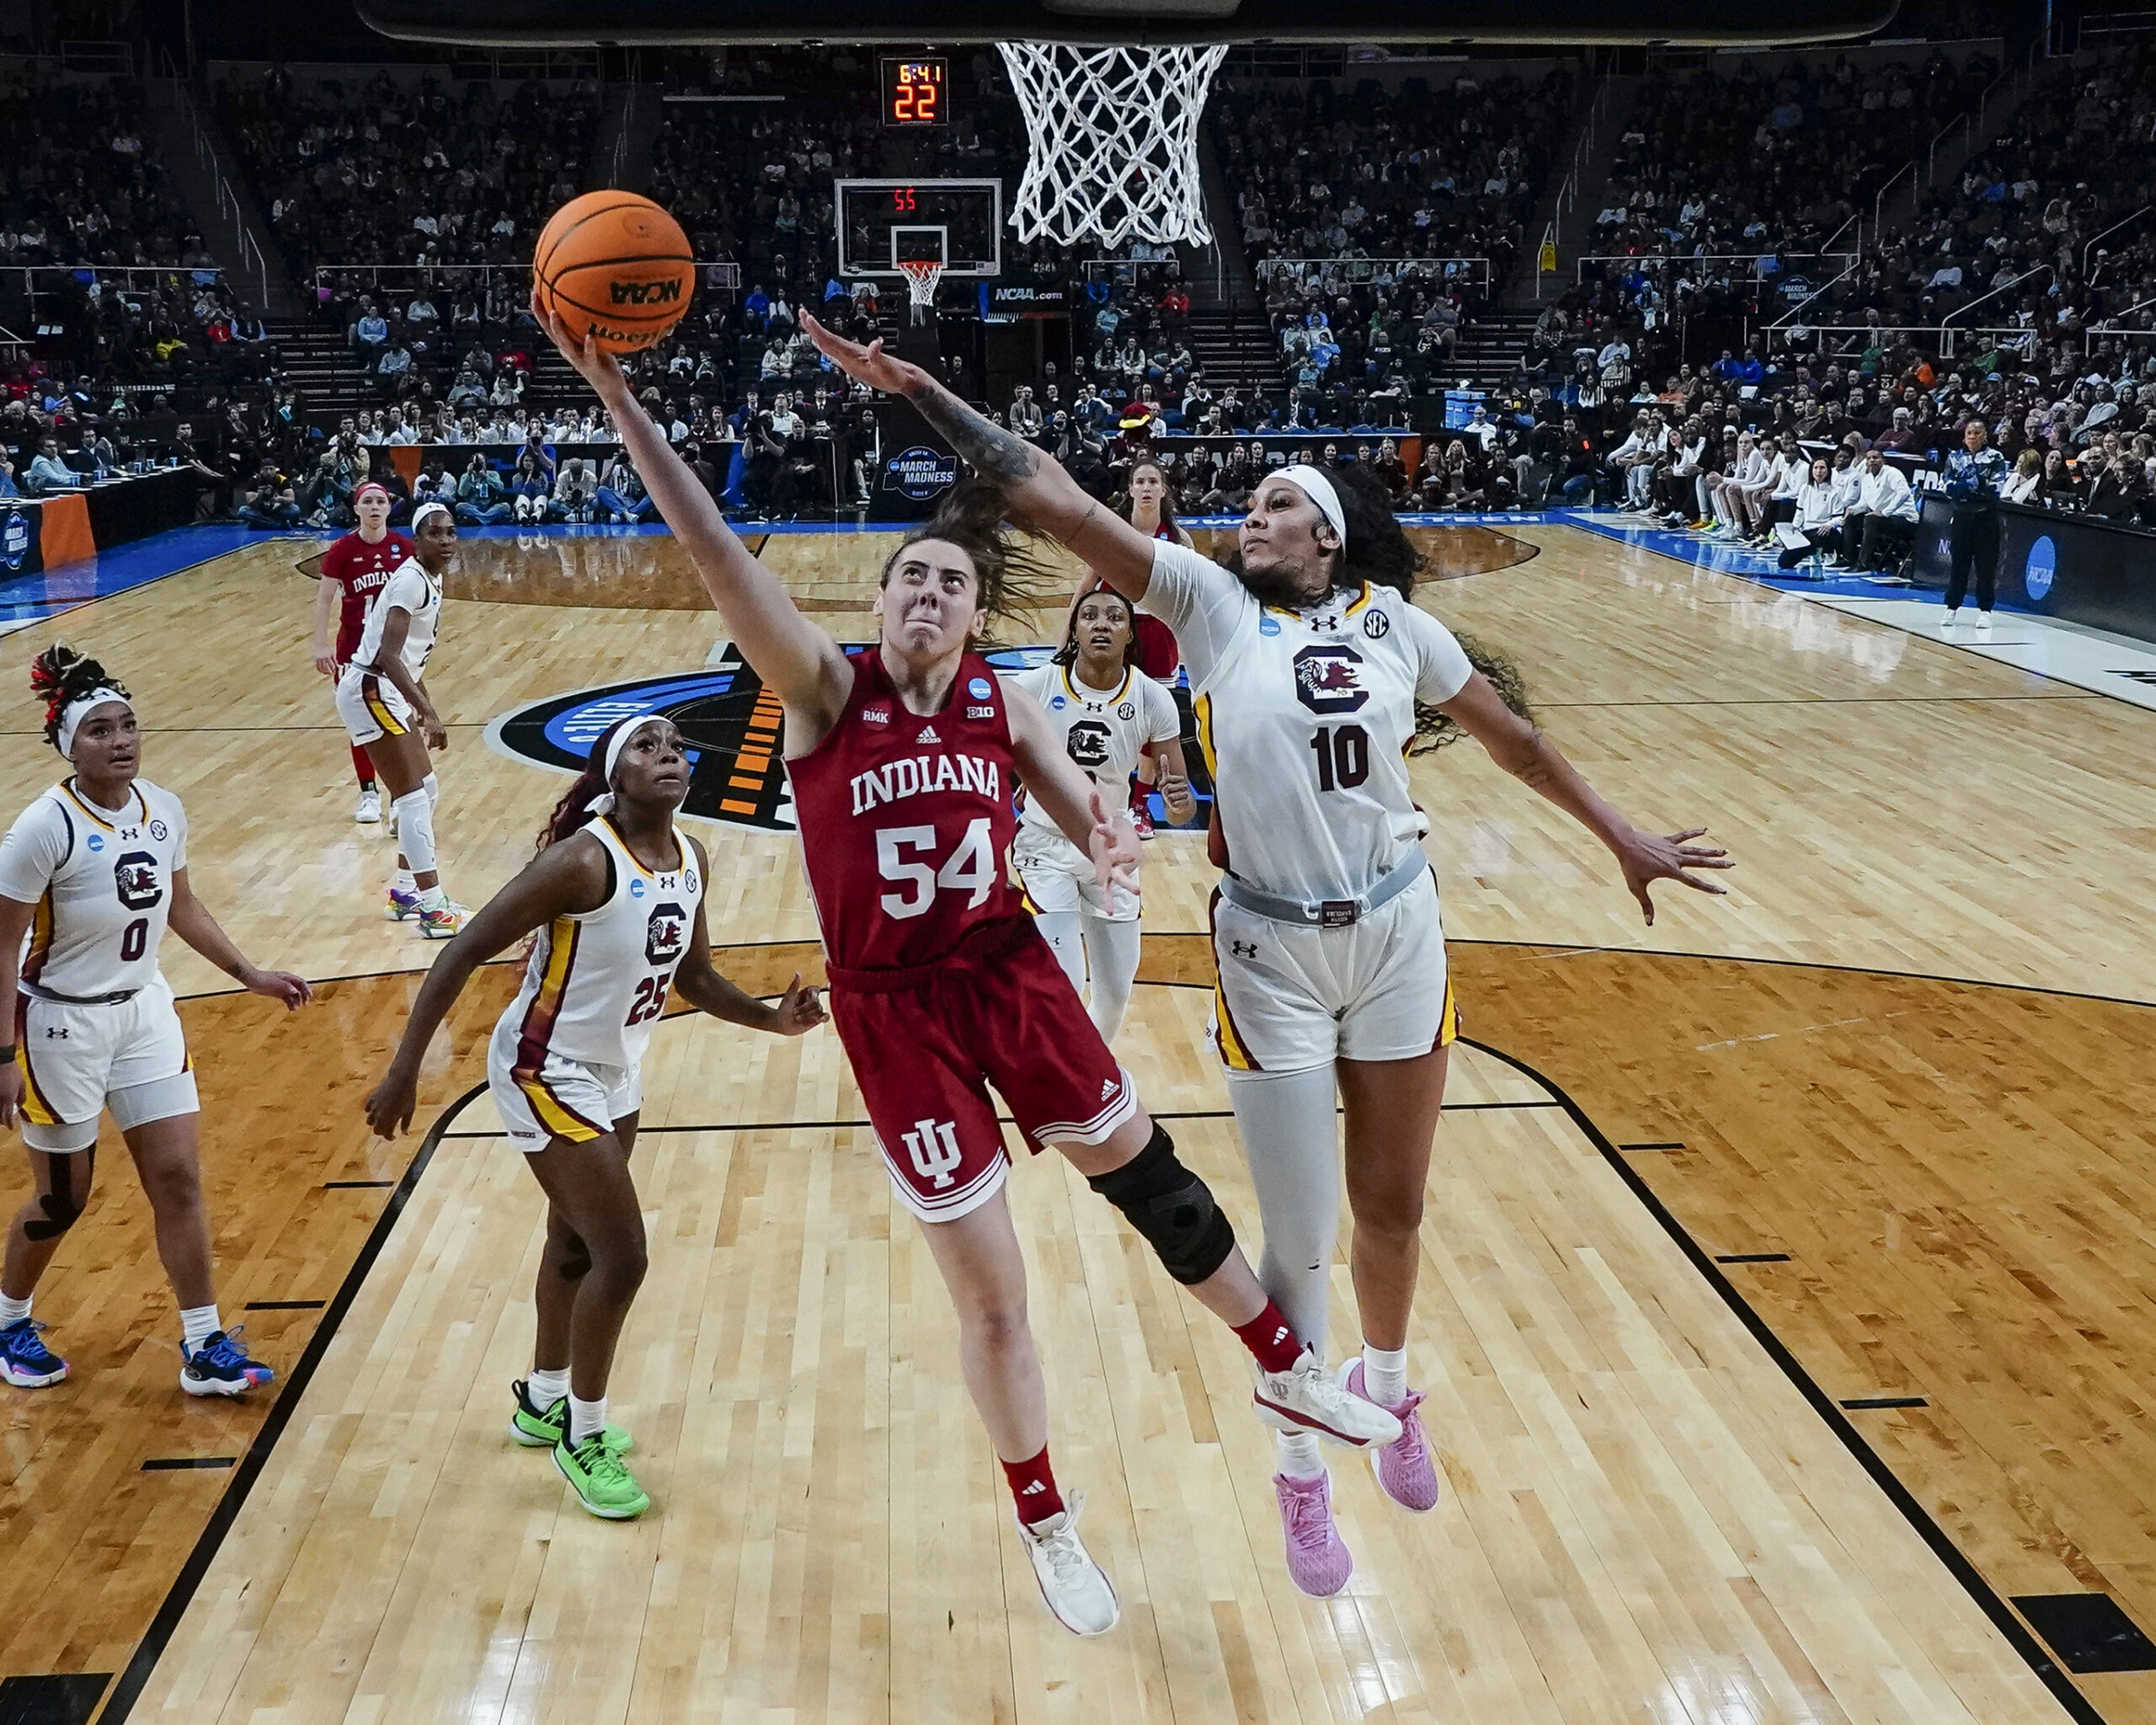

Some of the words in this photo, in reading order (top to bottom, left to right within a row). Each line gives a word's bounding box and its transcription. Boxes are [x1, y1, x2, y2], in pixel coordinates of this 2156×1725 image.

[899, 64, 941, 83] 6:41
[895, 85, 936, 119] 22
[894, 189, 916, 211] 55
[610, 277, 683, 305] NCAA
[995, 288, 1062, 301] NCAA.com
[899, 461, 937, 473] MARCH
[905, 472, 953, 483] MADNESS
[1364, 610, 1388, 638] SEC
[862, 710, 889, 724] RMK
[1310, 724, 1369, 792] 10
[850, 754, 1001, 816] INDIANA
[876, 817, 998, 920] 54
[120, 918, 149, 962] 0
[624, 971, 671, 1027] 25
